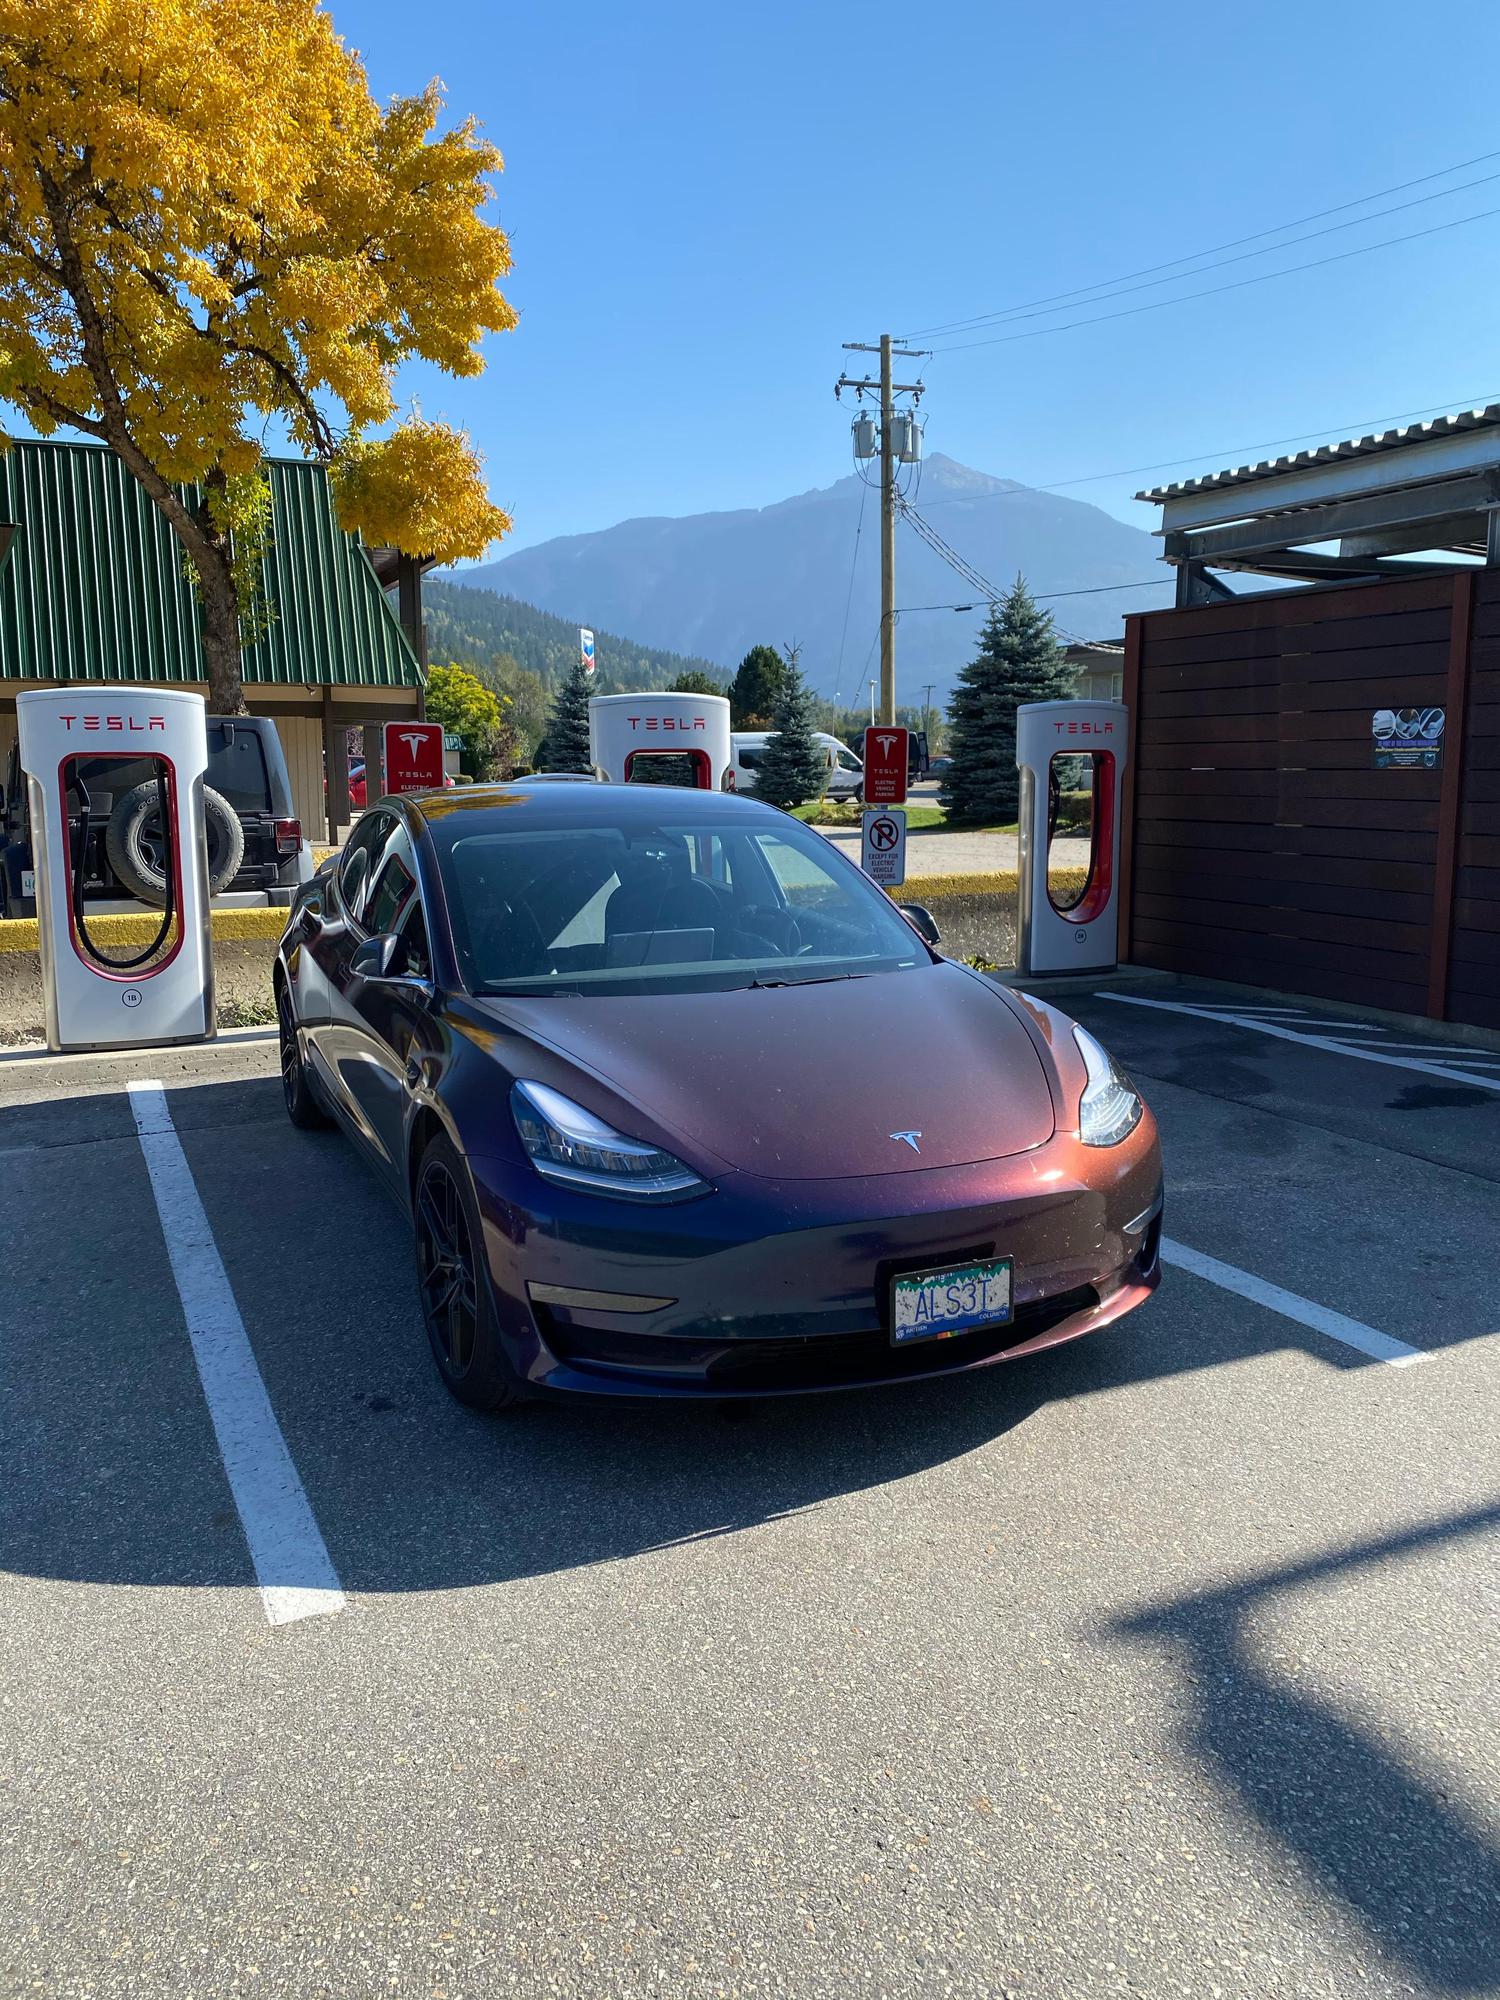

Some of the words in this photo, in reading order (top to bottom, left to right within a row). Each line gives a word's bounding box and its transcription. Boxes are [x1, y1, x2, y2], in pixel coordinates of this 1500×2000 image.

[59, 716, 165, 730] TESLA
[627, 718, 705, 730] TESLA
[1053, 722, 1113, 734] TESLA
[915, 1279, 992, 1322] ALS3T
